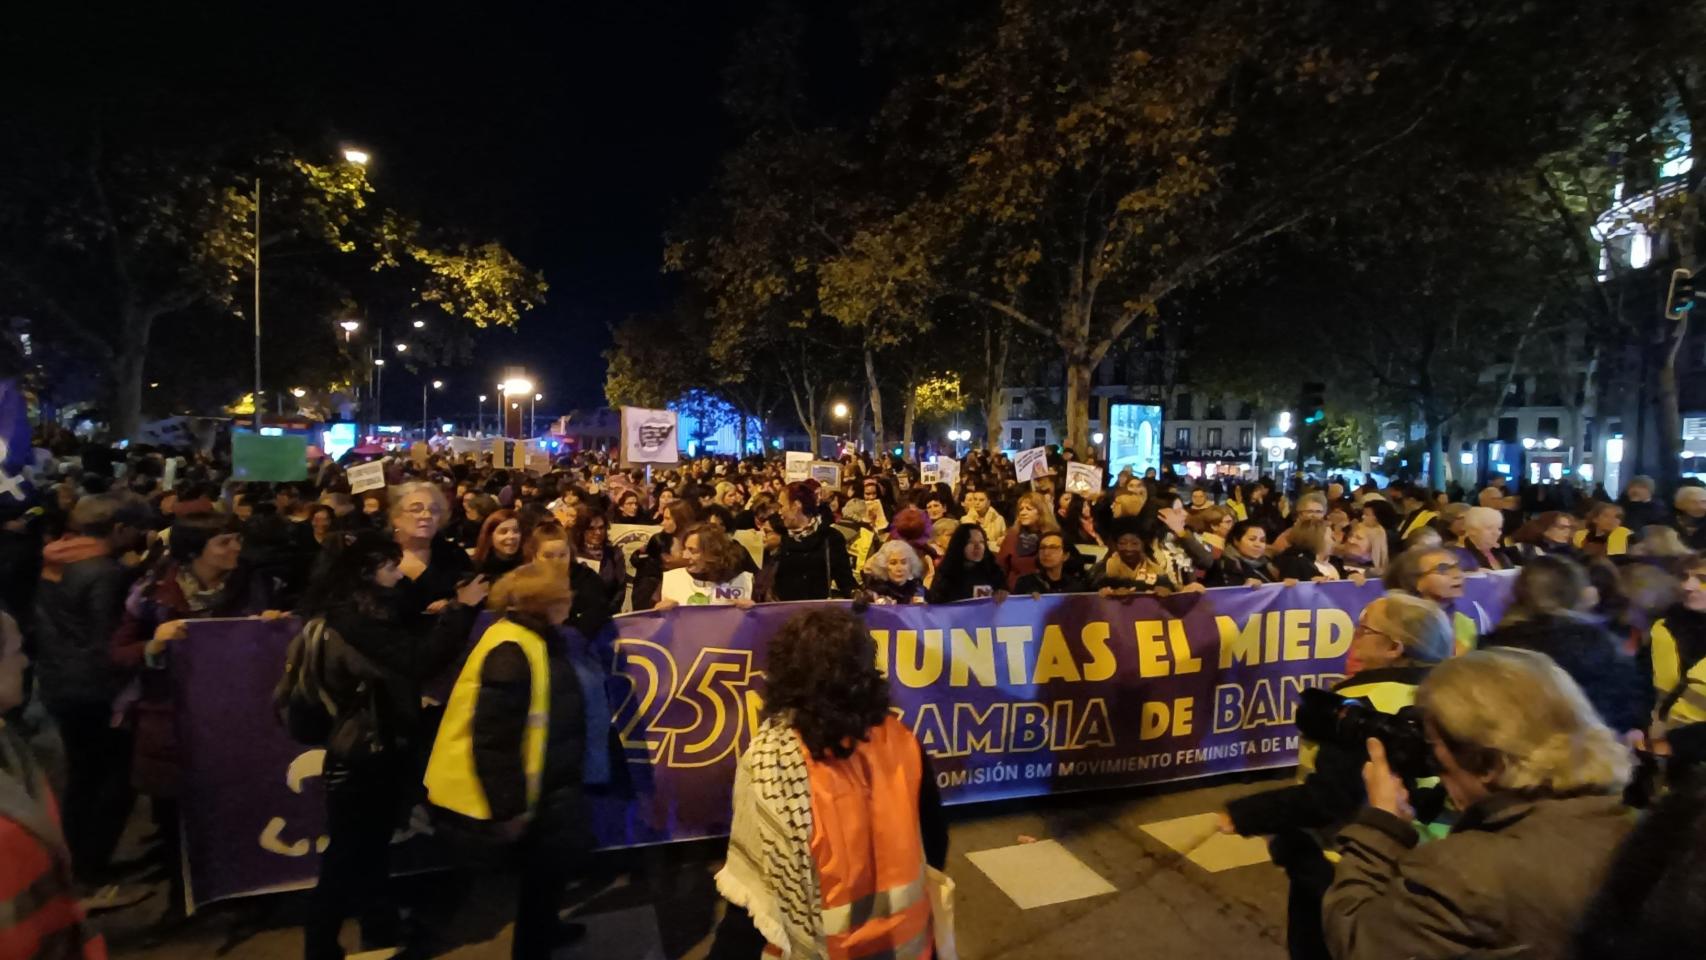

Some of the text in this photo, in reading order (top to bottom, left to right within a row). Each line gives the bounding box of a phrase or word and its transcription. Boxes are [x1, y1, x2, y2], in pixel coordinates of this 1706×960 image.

[1176, 448, 1237, 458] TIERRA
[1134, 618, 1202, 678] EL
[1214, 608, 1355, 670] MIED
[887, 673, 1350, 759] AMBIA DE BAN
[935, 736, 1300, 789] OMISIÓN 8M MOVIMIENTO FEMINISTA DE M
